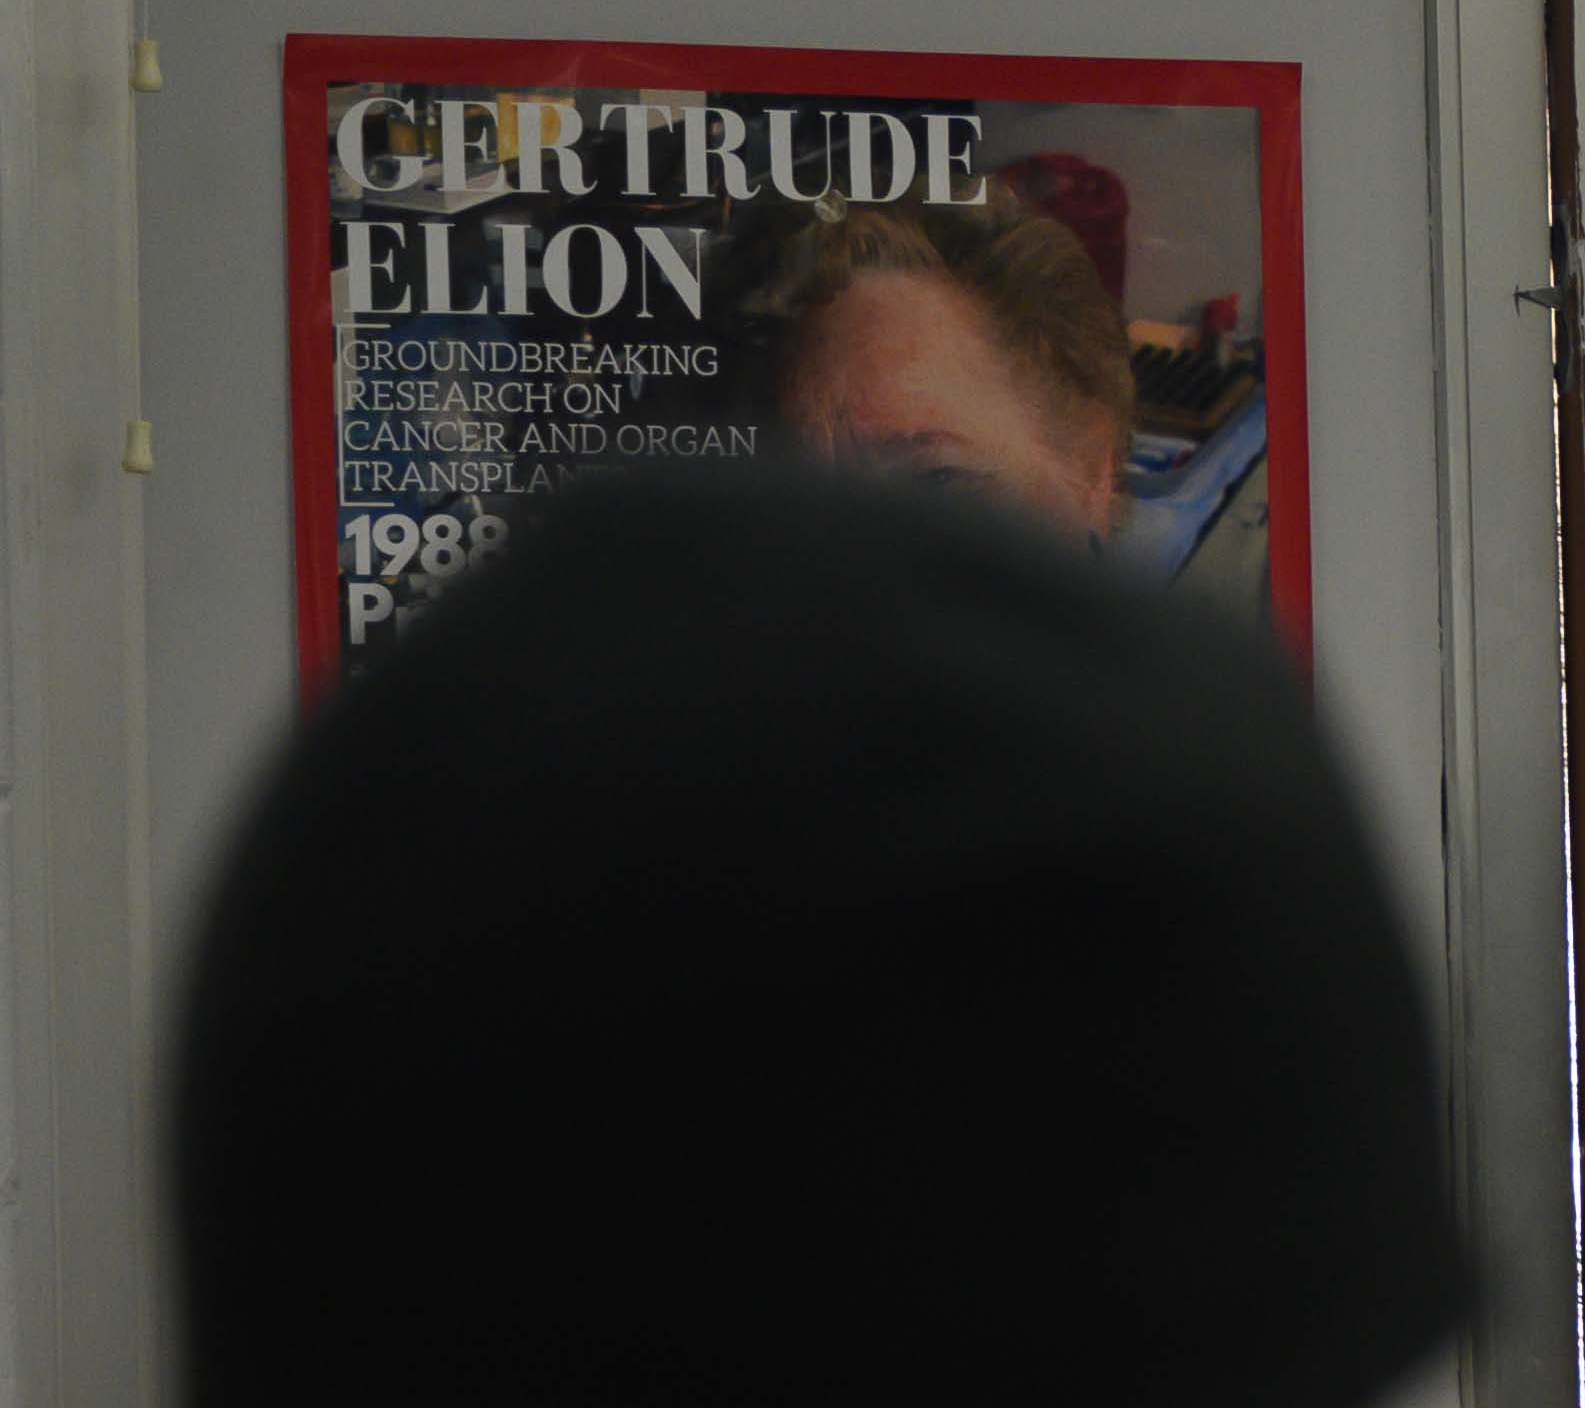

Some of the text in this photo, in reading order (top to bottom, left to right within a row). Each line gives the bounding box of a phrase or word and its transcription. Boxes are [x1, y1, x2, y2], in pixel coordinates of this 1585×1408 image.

[335, 96, 988, 206] GERTRUDE
[340, 221, 710, 320] ELION
[342, 340, 720, 377] GROUNDBREAKING
[343, 380, 622, 415] RESEARCH ON
[343, 421, 759, 458] CANCER AND ORGAN
[344, 513, 510, 577] 1988
